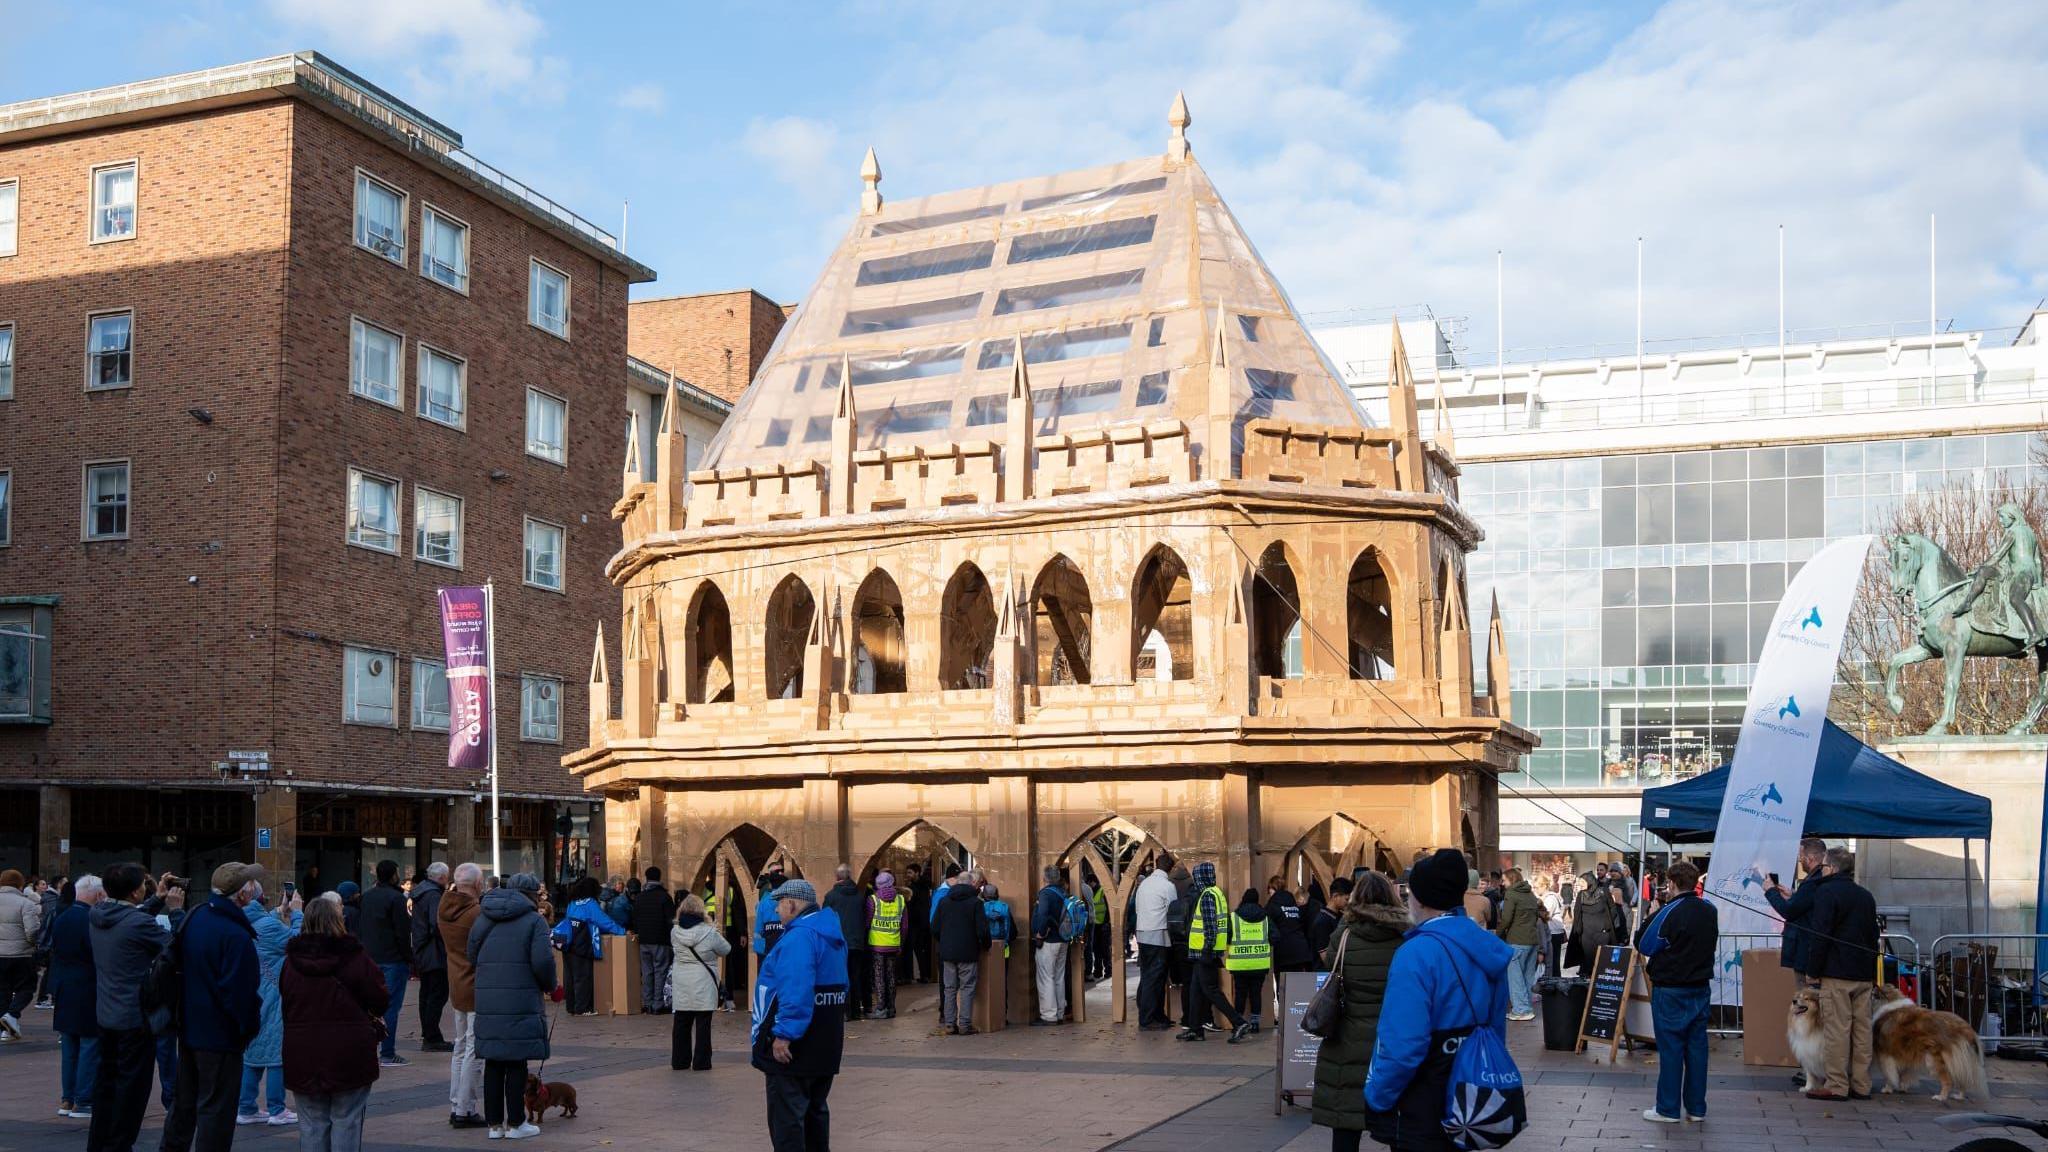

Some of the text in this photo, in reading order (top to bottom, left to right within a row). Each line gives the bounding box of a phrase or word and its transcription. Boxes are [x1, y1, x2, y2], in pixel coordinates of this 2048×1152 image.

[1753, 718, 1777, 731] Coventry
[1778, 724, 1789, 735] City
[1734, 804, 1792, 824] Coventry City Council
[1715, 888, 1740, 901] Coventry
[1234, 945, 1253, 954] EVENT
